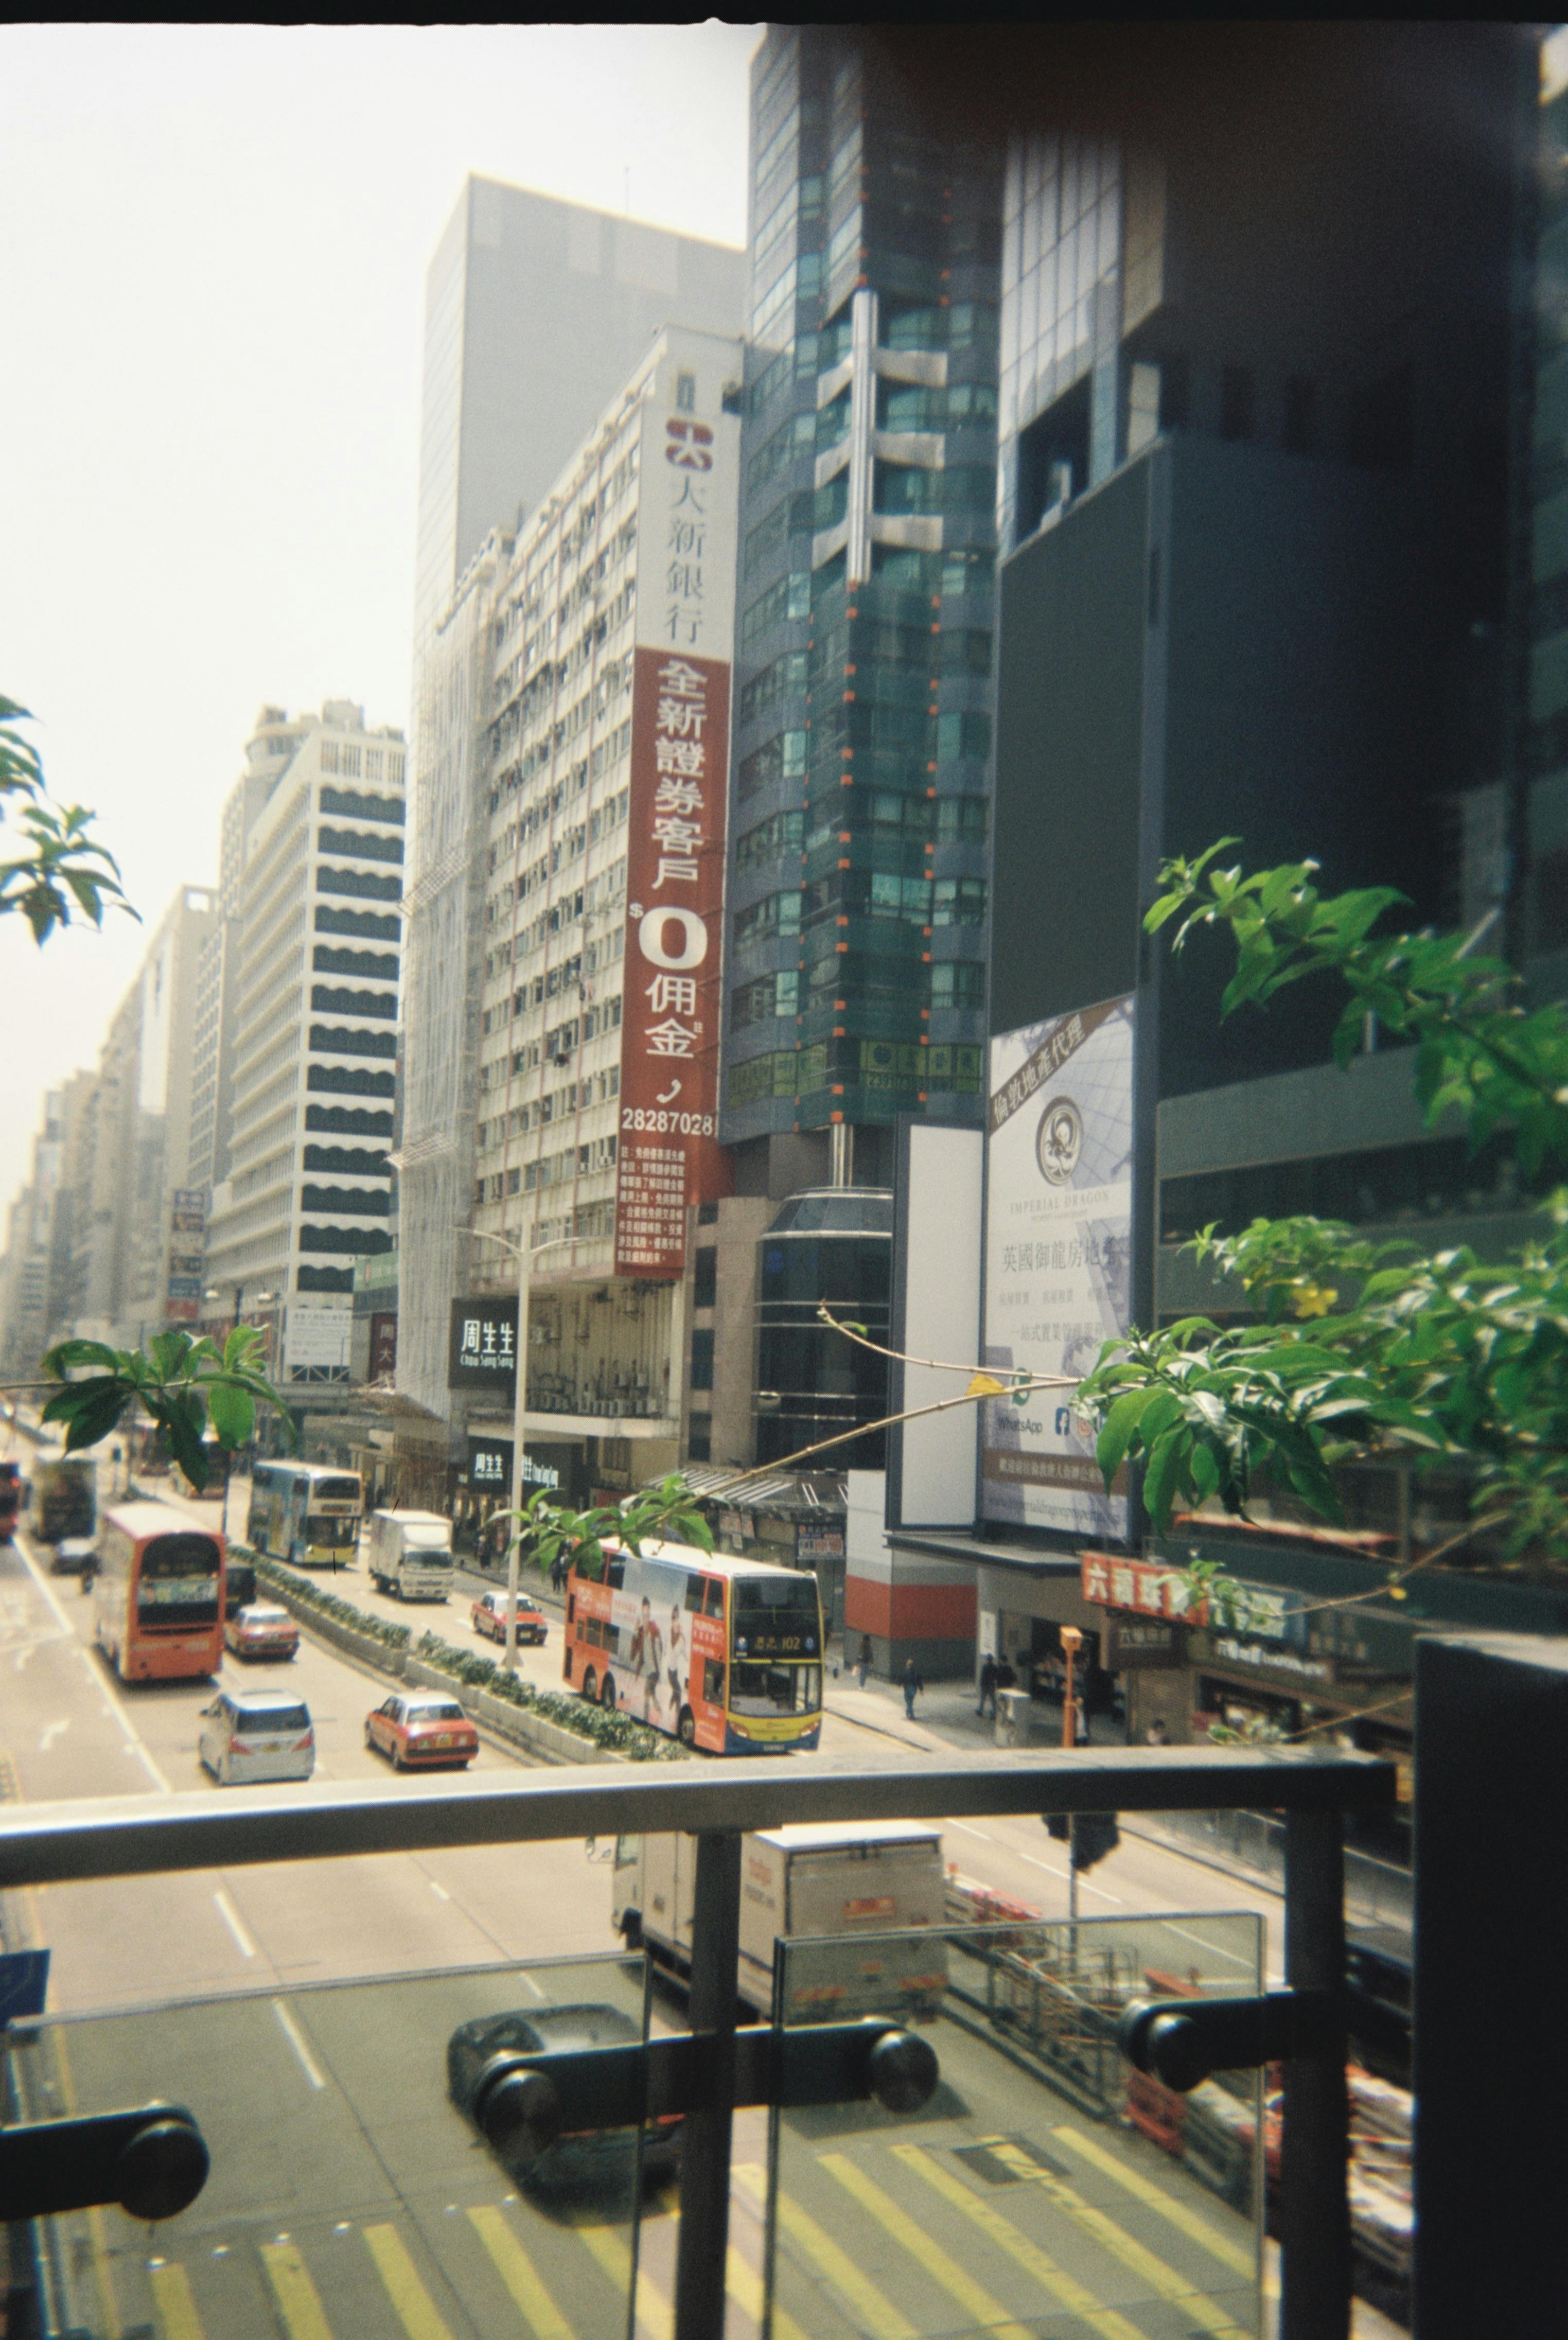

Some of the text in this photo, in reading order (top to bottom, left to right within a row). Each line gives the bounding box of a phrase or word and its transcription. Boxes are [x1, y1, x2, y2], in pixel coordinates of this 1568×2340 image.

[665, 474, 707, 645] 大新銀行
[644, 974, 697, 1058] 佣金
[621, 1107, 713, 1136] 28287028
[1010, 1189, 1109, 1215] IMPERIAL DRAGON
[461, 1319, 514, 1354] 周生生
[998, 1417, 1043, 1436] WhatsApp
